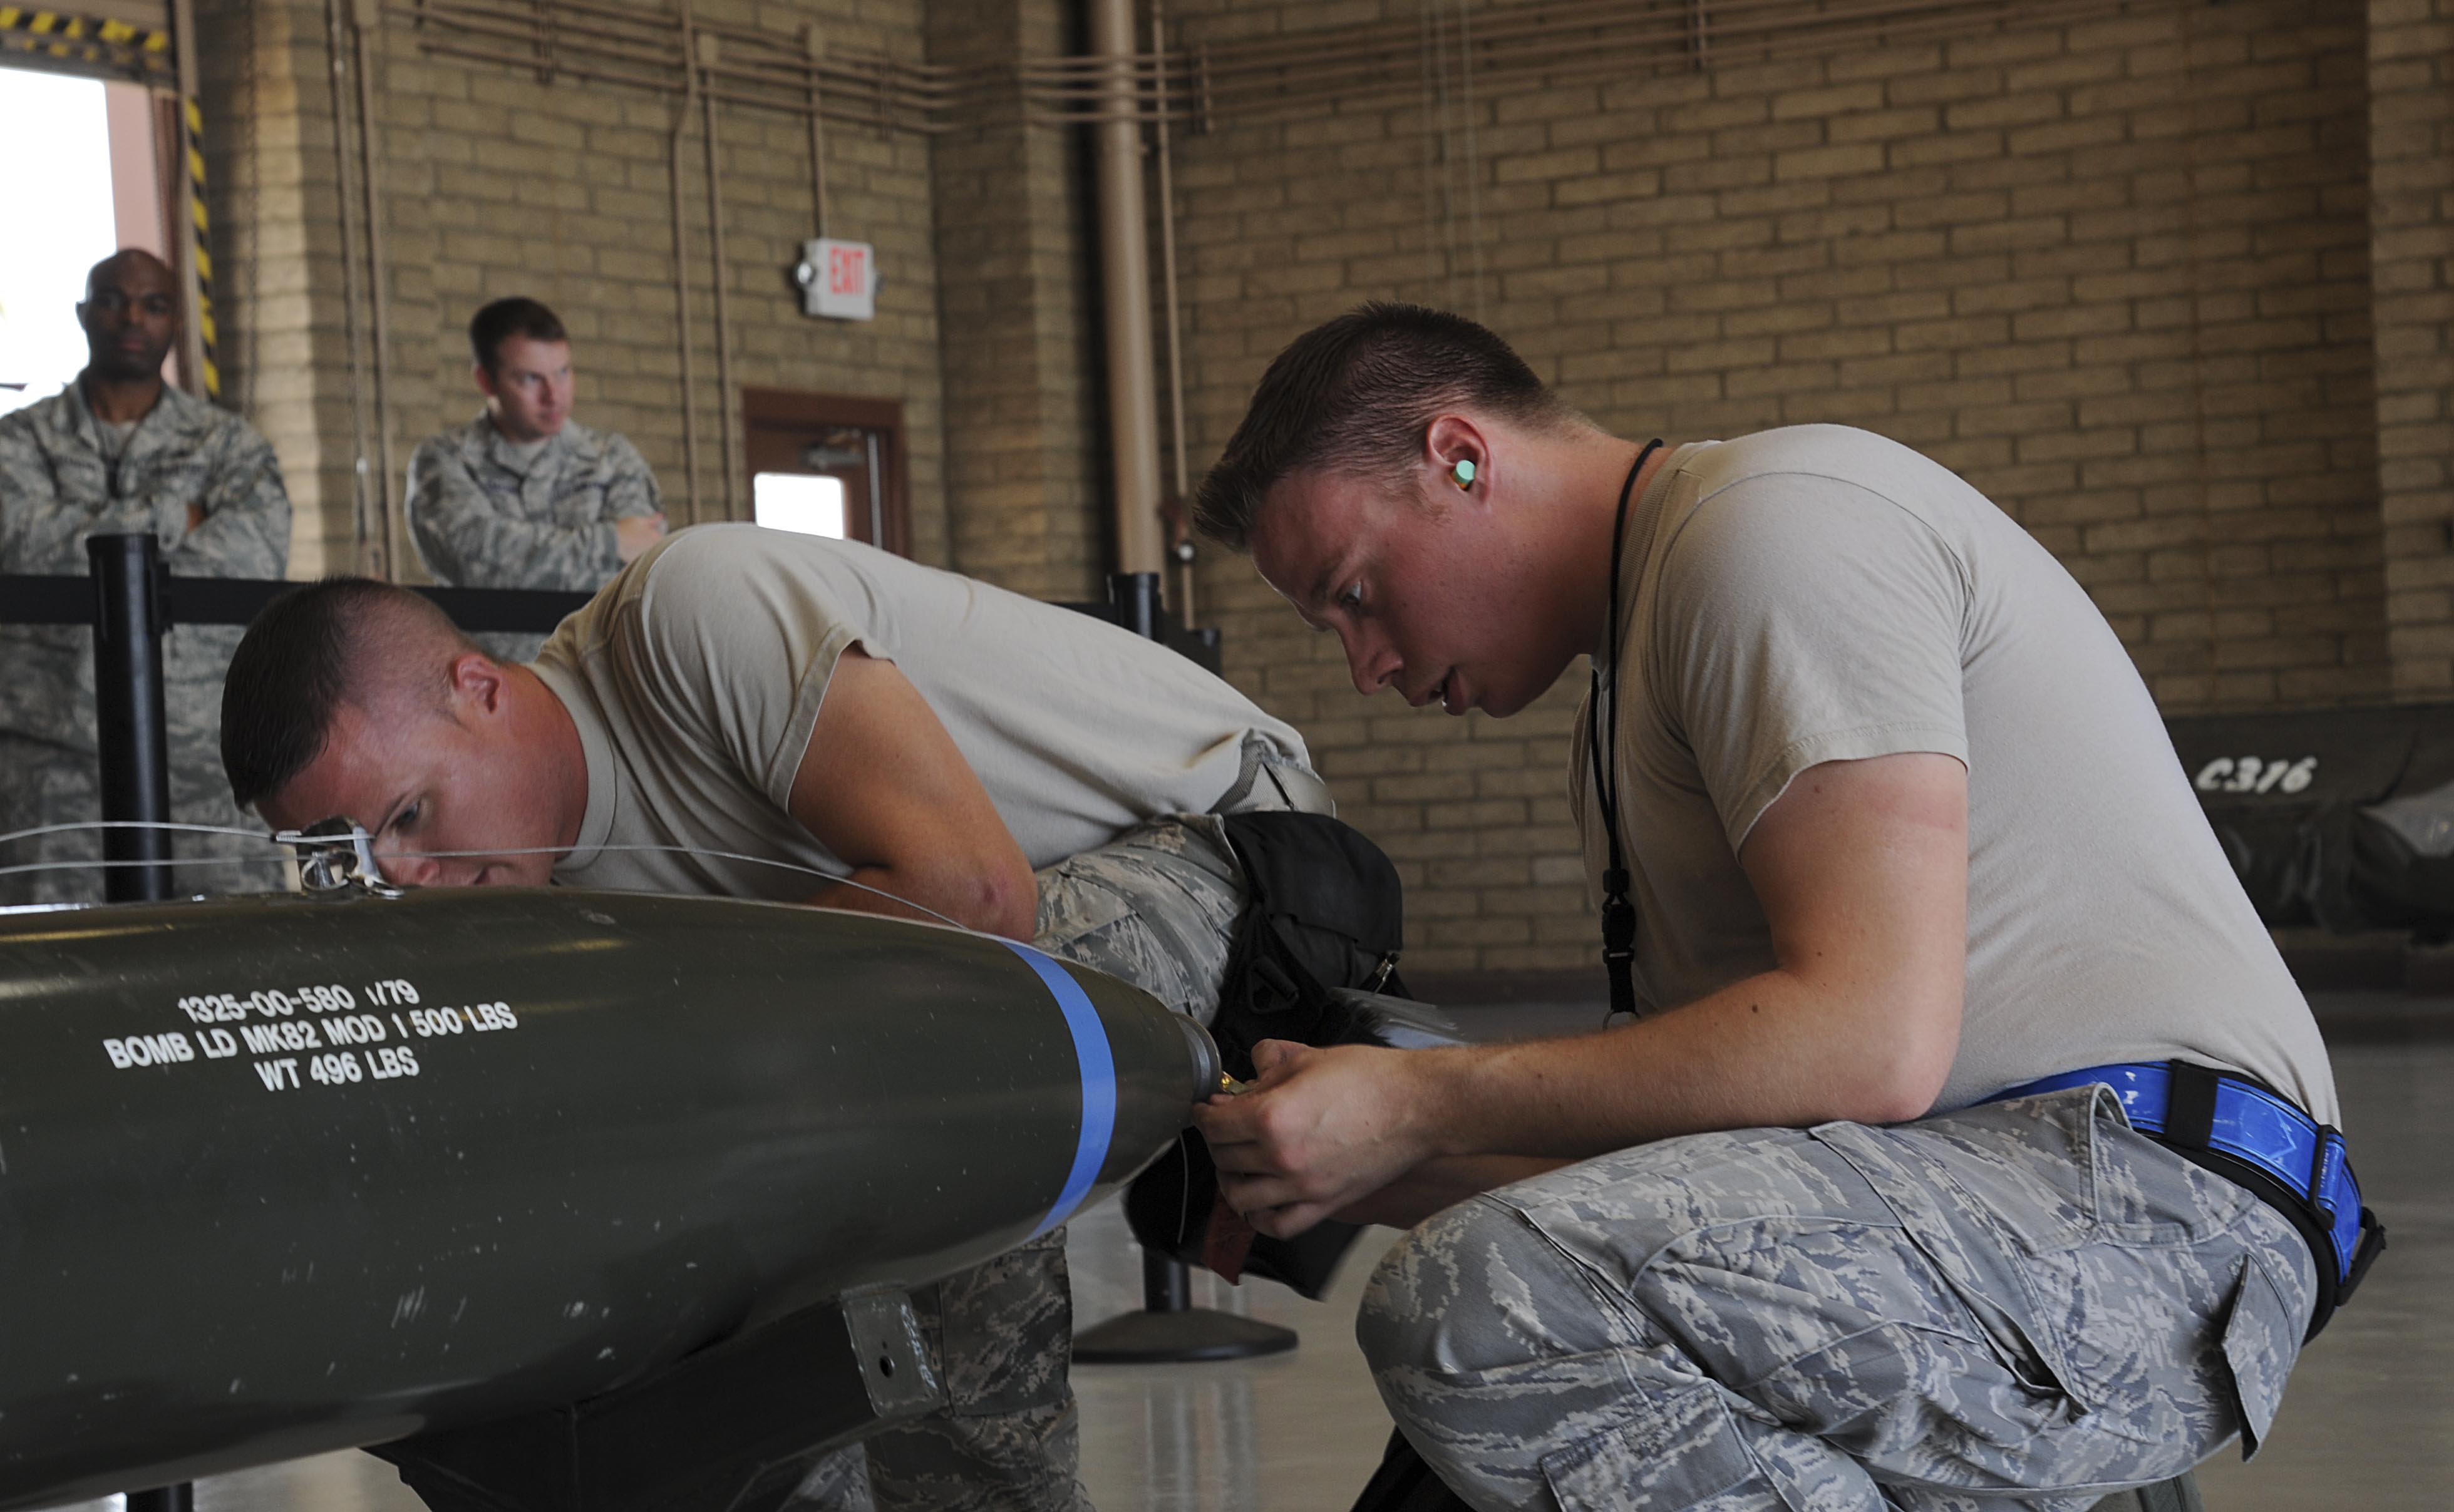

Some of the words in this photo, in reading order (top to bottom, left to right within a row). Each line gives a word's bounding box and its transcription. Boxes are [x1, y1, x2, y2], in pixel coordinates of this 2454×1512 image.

[829, 246, 865, 296] EXIT
[177, 984, 356, 1024] 1325-00-580
[103, 1032, 195, 1069] BOMB
[195, 1028, 238, 1059] LD
[239, 1020, 322, 1054] MK82
[320, 1014, 387, 1046] MOD
[408, 1006, 464, 1038] 500
[463, 1001, 518, 1032] LBS
[254, 1057, 301, 1092] WT
[309, 1051, 363, 1086] 496
[364, 1046, 420, 1080] LBS
